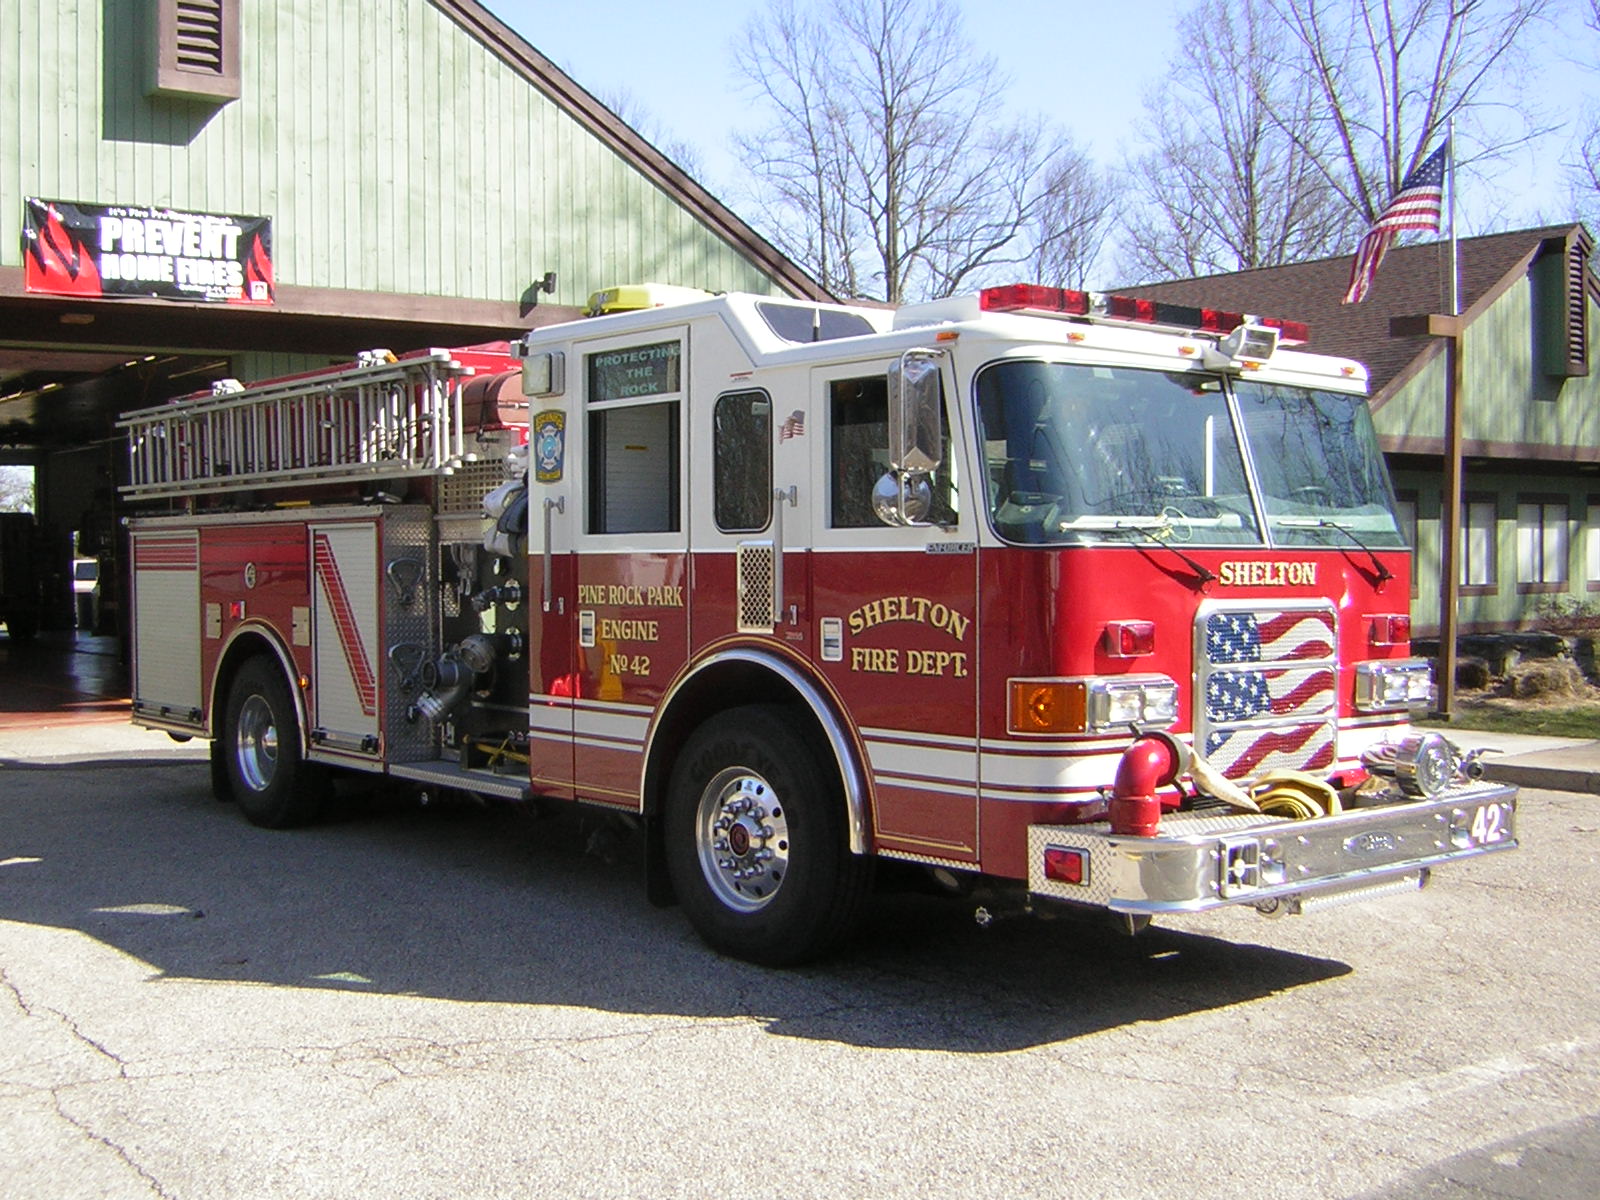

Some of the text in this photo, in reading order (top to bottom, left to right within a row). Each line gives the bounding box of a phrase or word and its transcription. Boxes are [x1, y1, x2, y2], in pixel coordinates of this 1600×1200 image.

[100, 216, 243, 260] PREVENT
[100, 253, 244, 287] HOME FIRES
[595, 345, 680, 368] PROTECTING
[626, 366, 653, 379] THE
[621, 382, 658, 396] ROCK
[1219, 561, 1317, 586] SHELTON
[577, 584, 684, 607] PINE ROCK PARK
[601, 619, 659, 641] ENGINE
[848, 596, 971, 641] SHELTON
[630, 655, 650, 676] 42
[851, 647, 968, 678] FIRE DEPT.
[1471, 803, 1501, 844] 42
